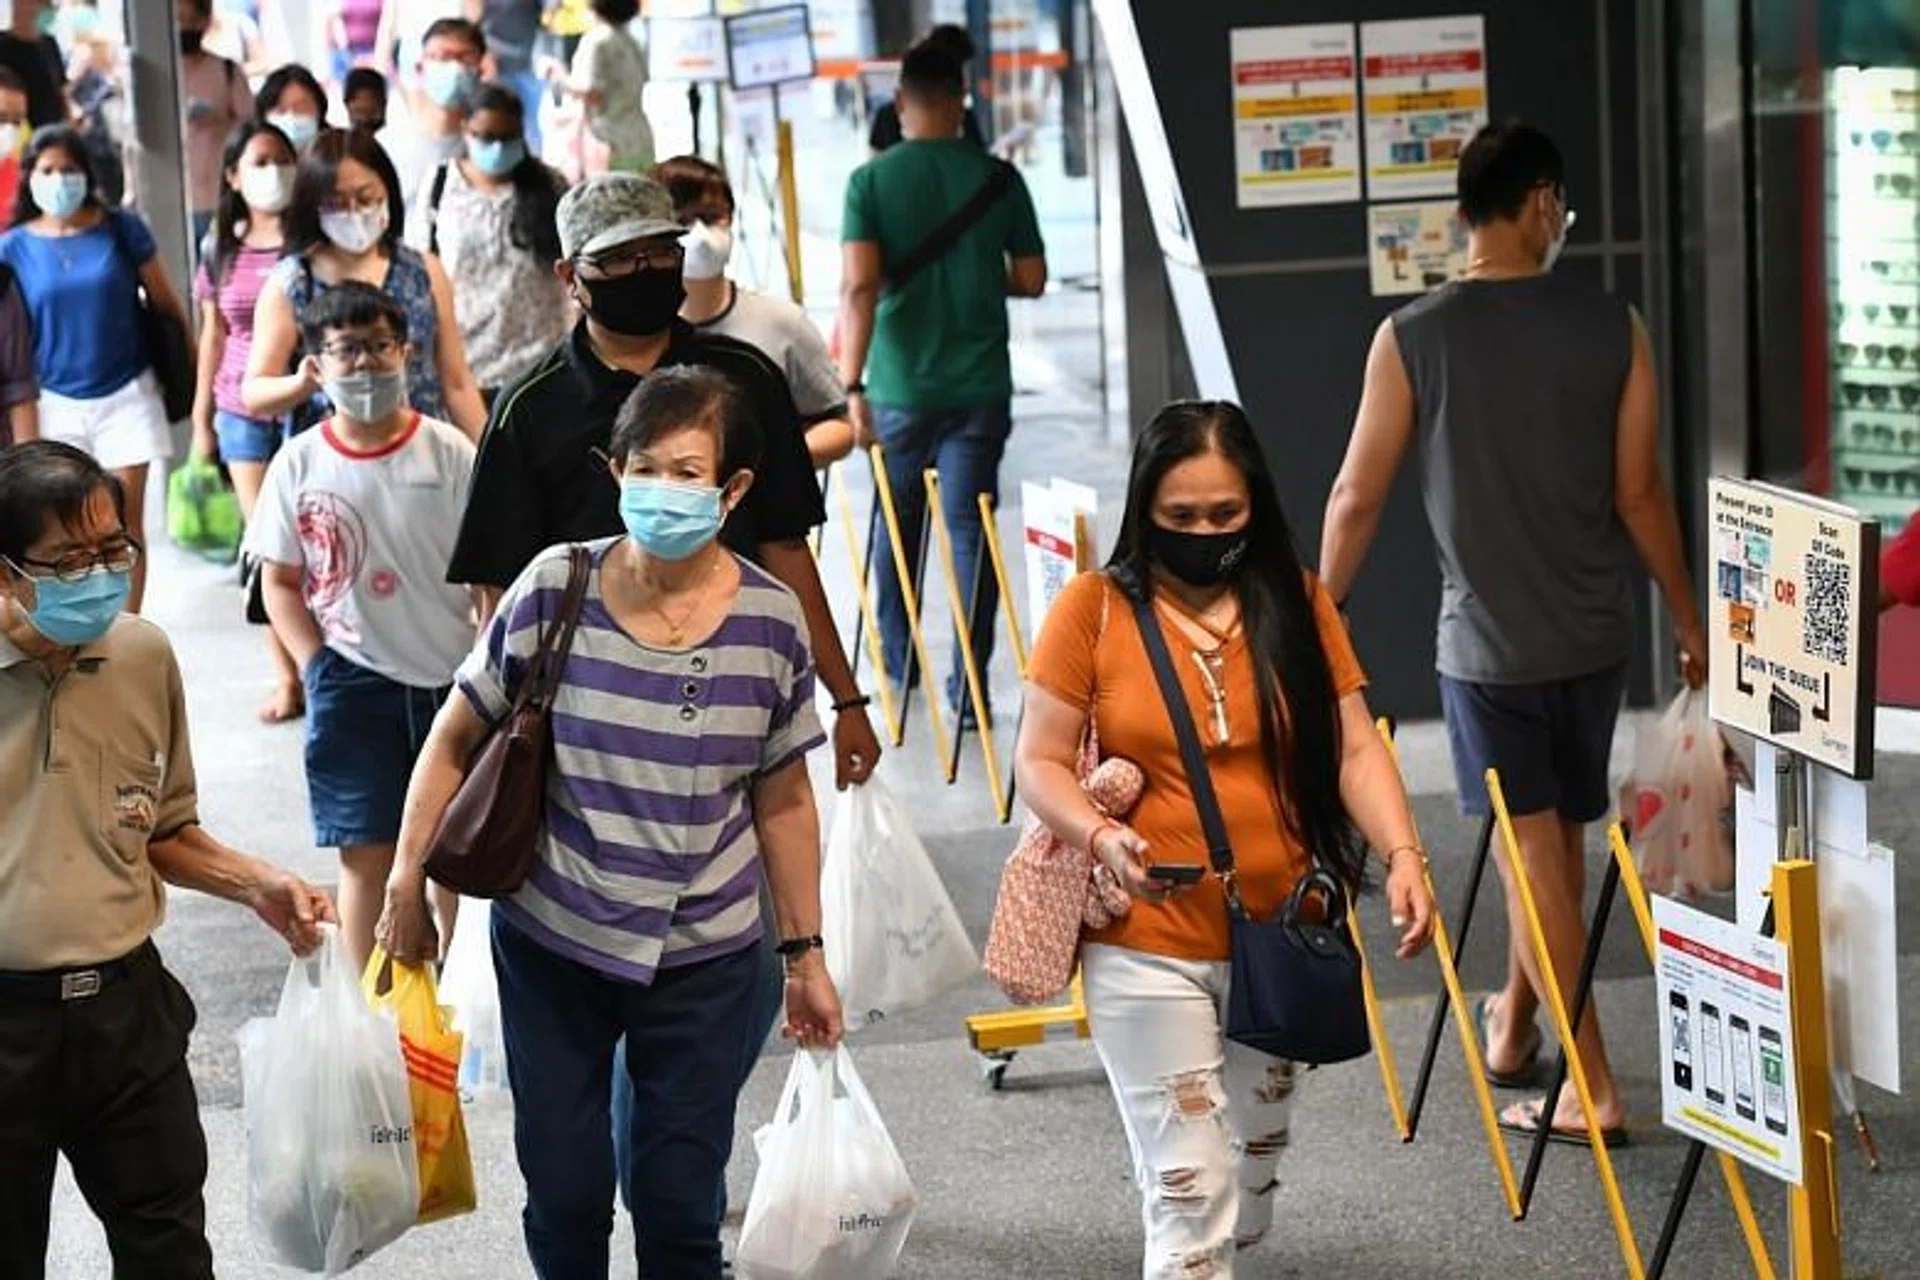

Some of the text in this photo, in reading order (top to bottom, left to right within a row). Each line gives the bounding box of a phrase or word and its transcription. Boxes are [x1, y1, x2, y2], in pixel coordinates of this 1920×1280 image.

[1725, 514, 1739, 528] the
[1740, 517, 1773, 537] Entrance
[1819, 521, 1838, 538] Scan
[1775, 578, 1796, 607] OR
[1745, 655, 1820, 693] JOIN THE QUEUE
